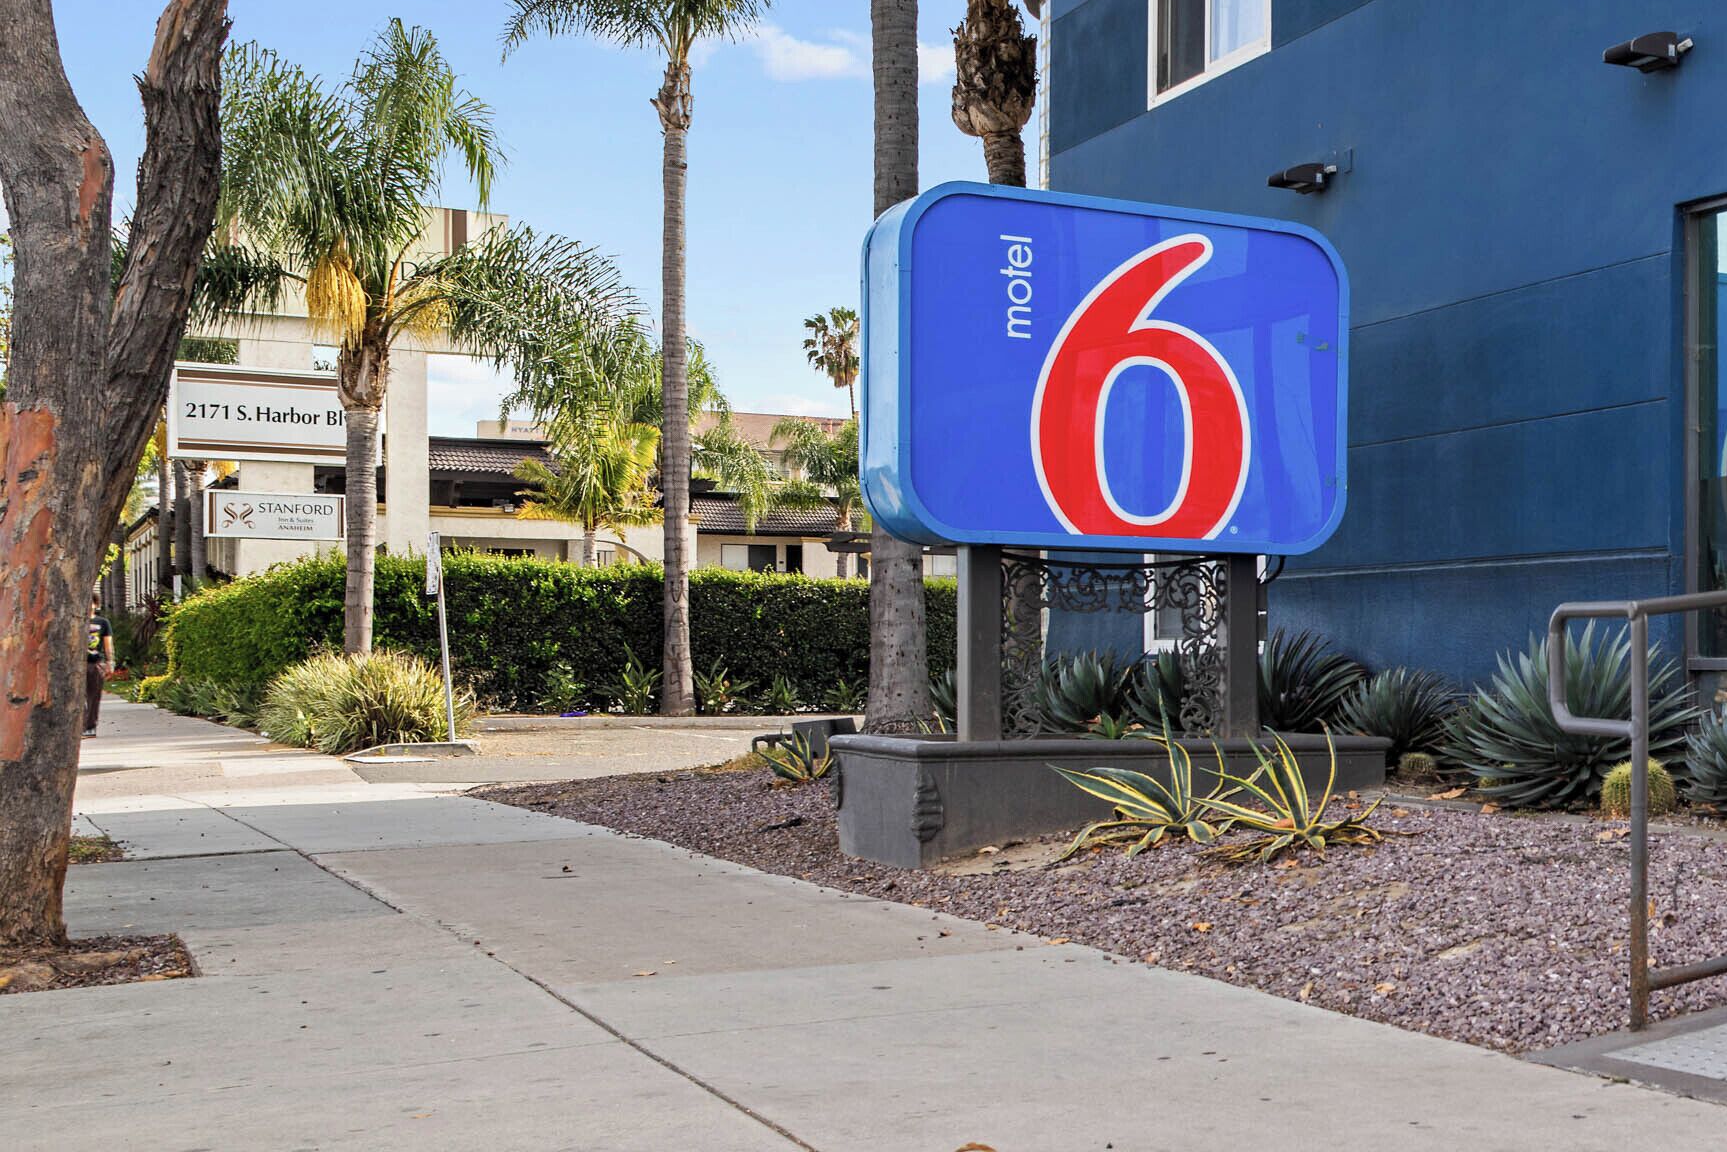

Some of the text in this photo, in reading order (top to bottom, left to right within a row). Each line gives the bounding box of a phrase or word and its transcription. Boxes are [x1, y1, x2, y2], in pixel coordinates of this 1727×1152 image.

[1000, 234, 1033, 339] motel
[1030, 233, 1252, 540] 6
[185, 402, 229, 420] 2171
[237, 404, 252, 421] S.
[256, 406, 321, 425] Harbor
[258, 502, 333, 516] STANFORD
[278, 524, 313, 532] ANAHEIM
